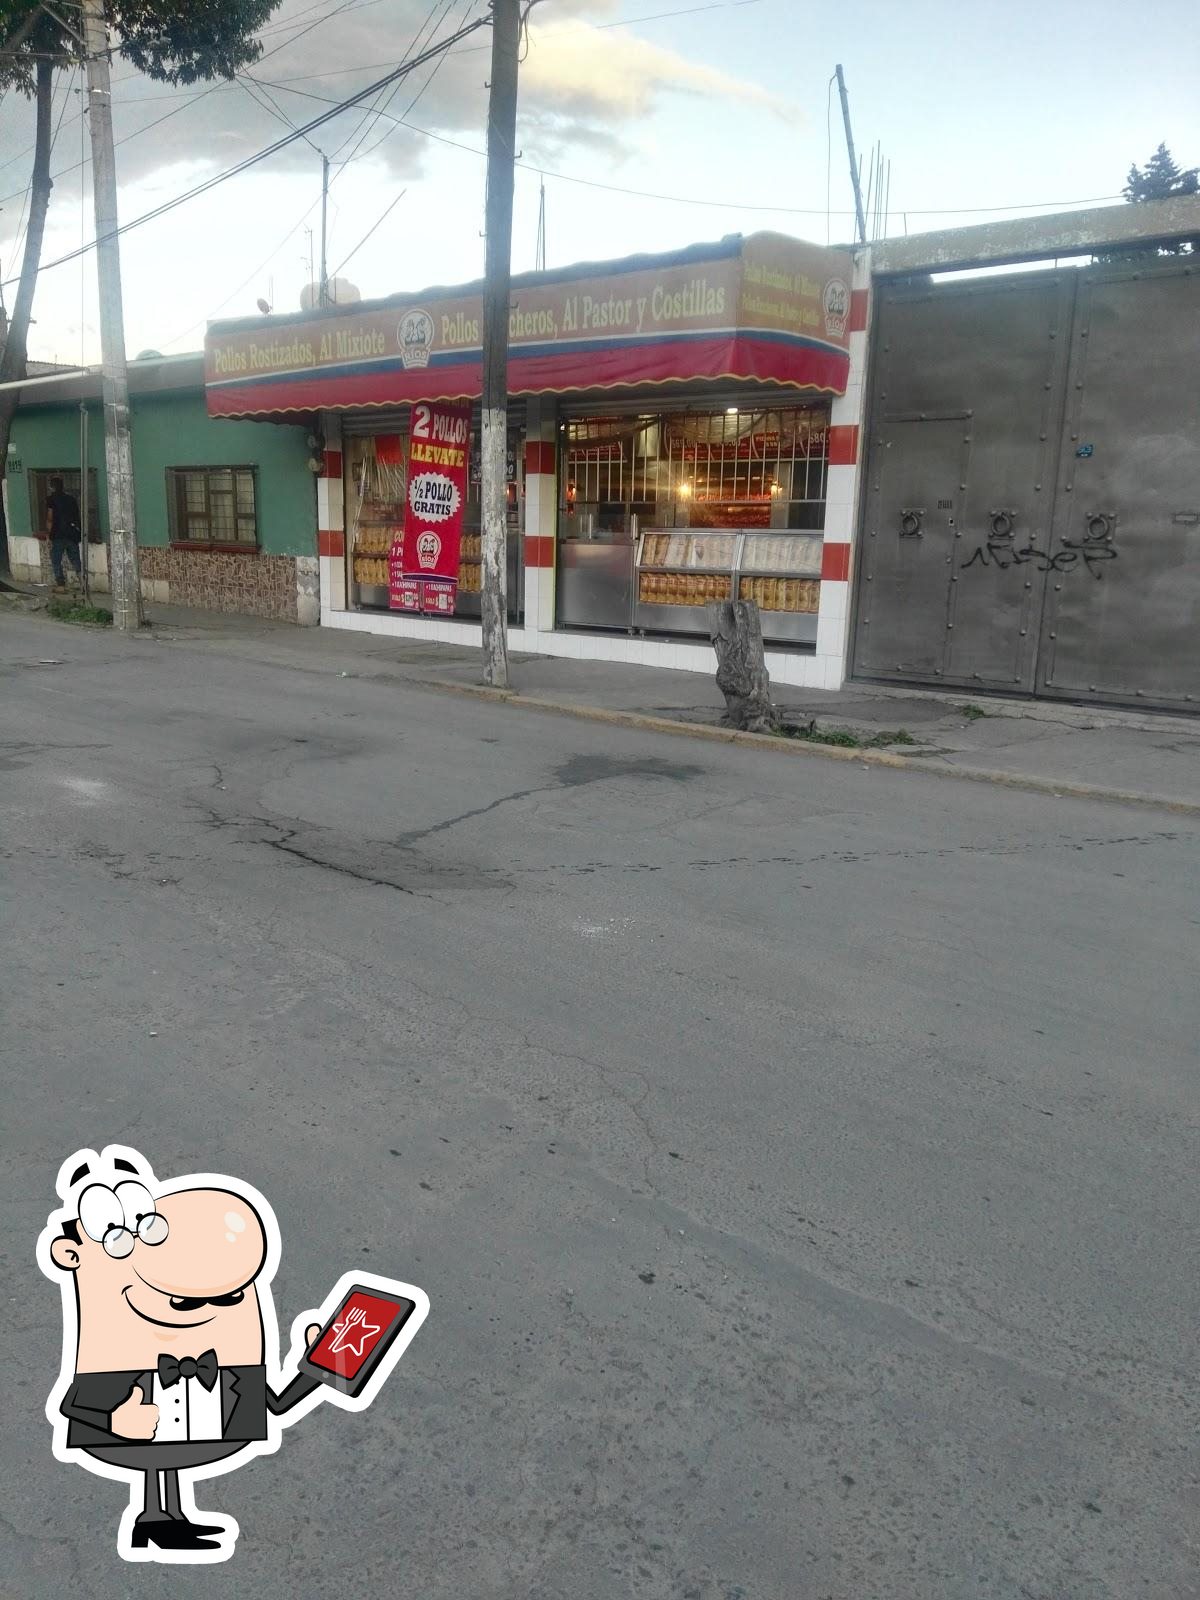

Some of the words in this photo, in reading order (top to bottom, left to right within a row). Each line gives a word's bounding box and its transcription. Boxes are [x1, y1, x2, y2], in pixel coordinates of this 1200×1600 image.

[441, 313, 479, 345] Pollos
[507, 303, 558, 338] cheros,
[562, 297, 578, 331] Al
[583, 291, 632, 329] Pastor
[636, 296, 647, 330] y
[651, 279, 726, 321] Costillas
[214, 348, 247, 374] Pollos
[249, 341, 317, 370] Rostizados,
[319, 333, 333, 361] Al
[336, 327, 386, 359] Mixiote
[413, 405, 431, 438] 2
[432, 413, 468, 444] POLLOS
[410, 442, 465, 467] LLEVATE
[424, 481, 453, 502] POLLO
[414, 500, 451, 517] GRATIS
